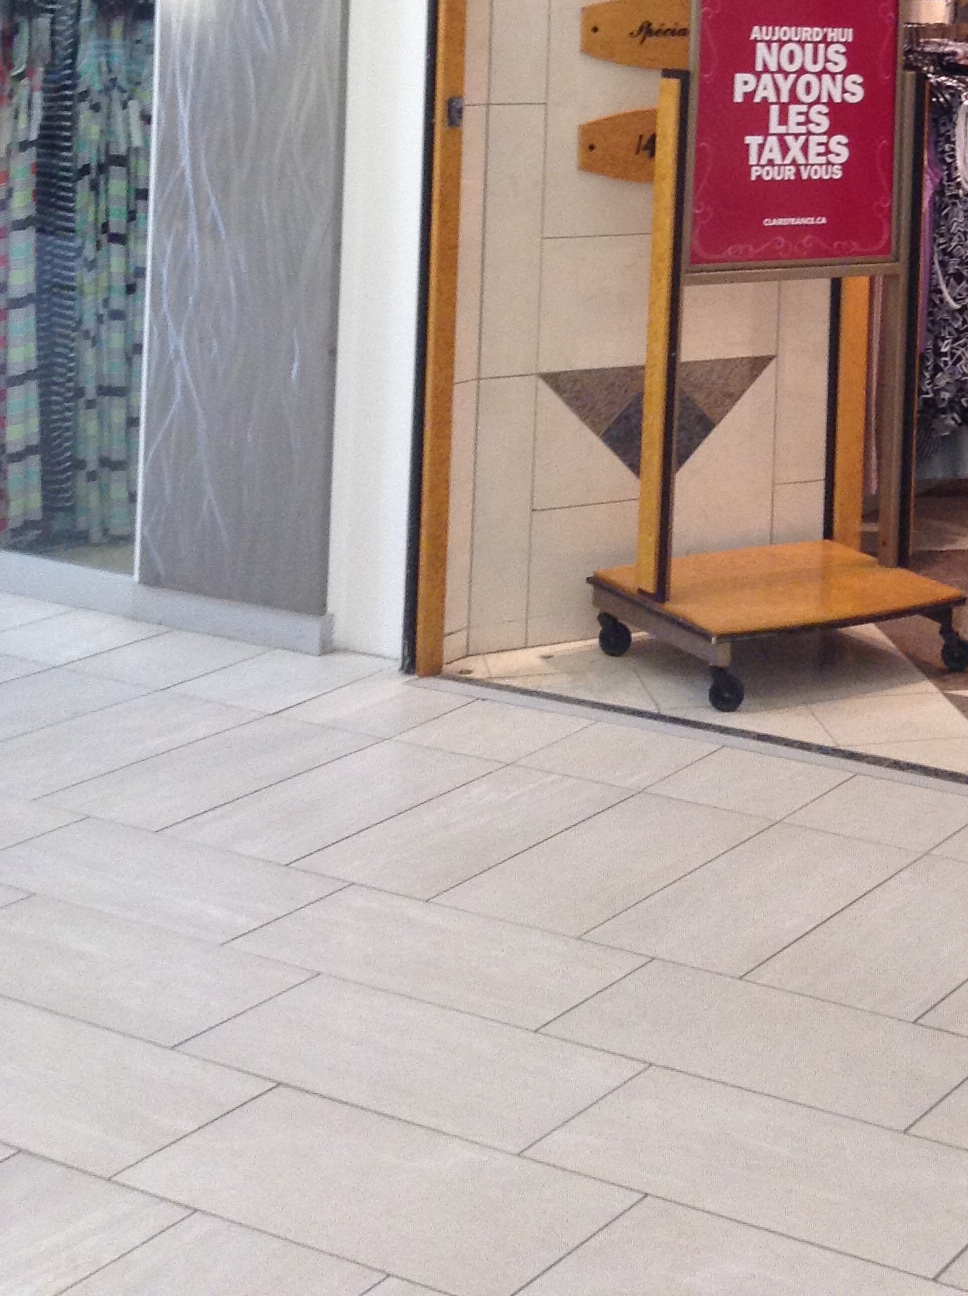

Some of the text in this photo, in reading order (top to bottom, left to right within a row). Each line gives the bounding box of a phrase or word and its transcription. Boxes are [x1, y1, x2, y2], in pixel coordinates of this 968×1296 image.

[629, 20, 690, 45] Spécia
[750, 25, 853, 42] AUJOURD'HUI
[754, 42, 848, 72] NOUS
[733, 73, 865, 103] PAYONS
[768, 104, 831, 134] LES
[743, 135, 850, 165] TAXES
[750, 164, 843, 181] POUR VOUS
